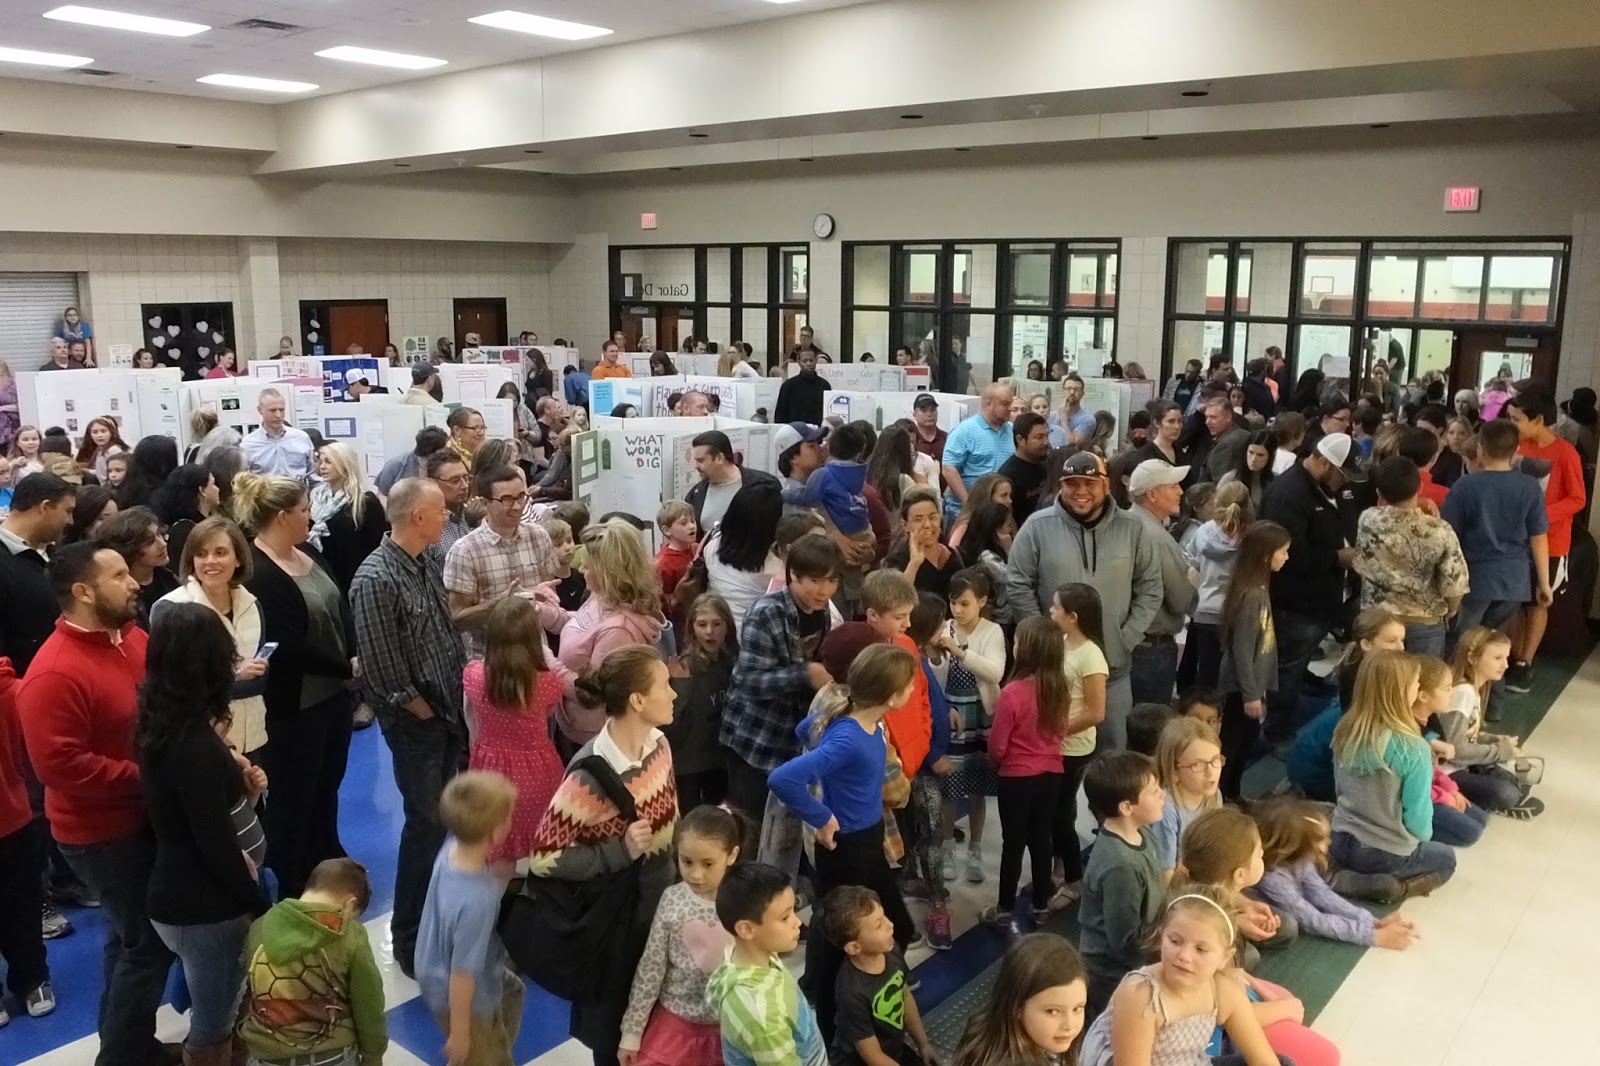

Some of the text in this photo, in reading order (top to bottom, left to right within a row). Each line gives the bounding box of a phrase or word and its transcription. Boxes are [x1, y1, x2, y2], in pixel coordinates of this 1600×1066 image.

[1450, 189, 1475, 207] EXIT
[625, 434, 665, 445] WHAT
[625, 446, 660, 456] WORM
[636, 457, 660, 468] DIG
